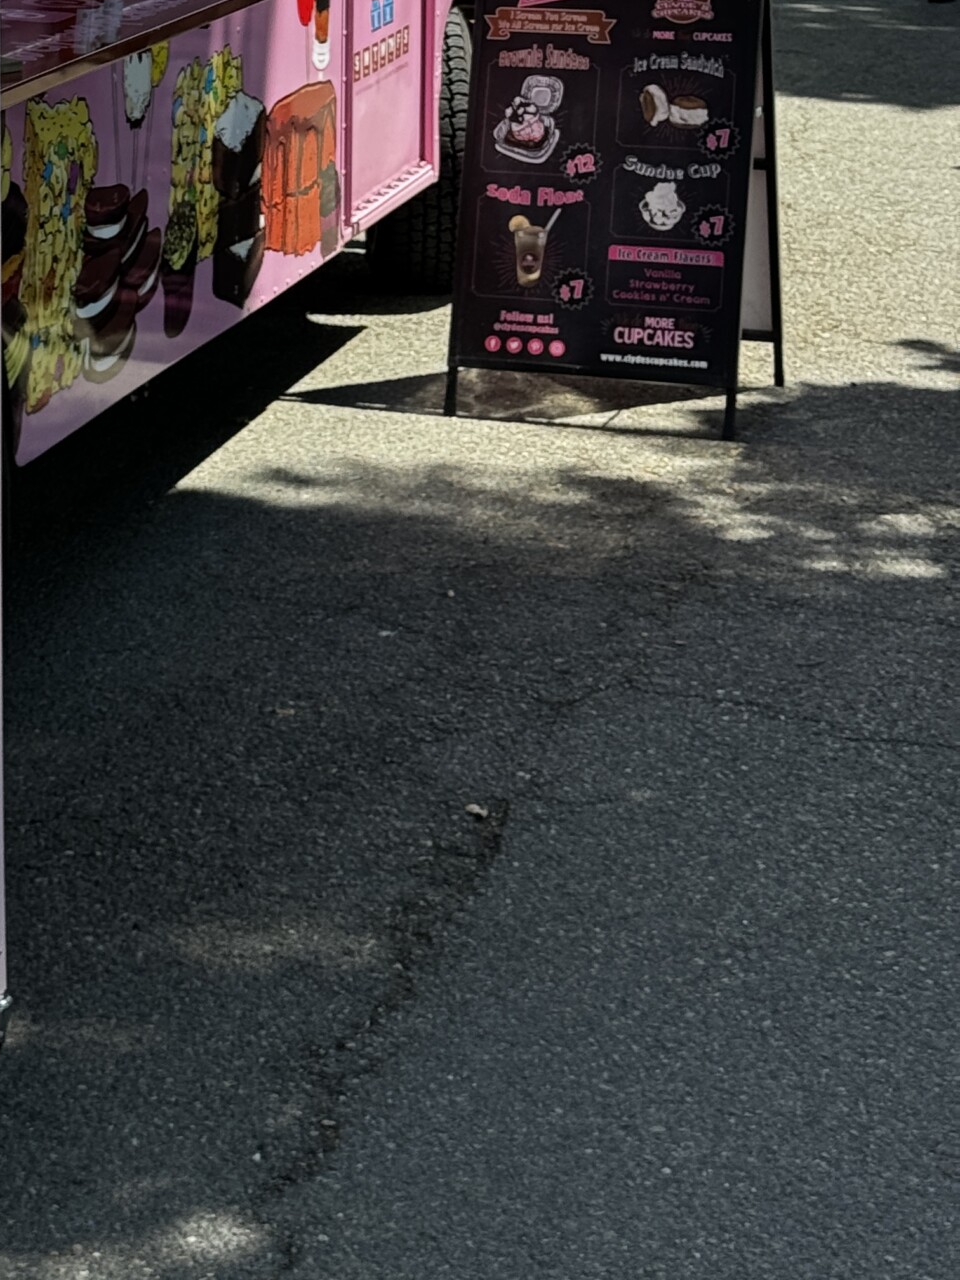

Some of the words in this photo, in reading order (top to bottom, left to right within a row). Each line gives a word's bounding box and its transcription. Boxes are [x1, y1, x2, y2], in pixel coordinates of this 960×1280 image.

[692, 32, 733, 42] CUPCAKES
[622, 154, 684, 180] Sundae
[687, 163, 721, 179] Cup
[618, 249, 632, 259] Ice
[637, 249, 669, 261] Cream
[674, 251, 712, 263] Flavors
[644, 268, 681, 279] Vanilla
[629, 280, 695, 293] Strawberry
[612, 289, 656, 301] Cookies
[673, 294, 711, 305] Cream
[644, 316, 675, 329] MORE
[613, 326, 695, 349] CUPCAKES
[600, 353, 708, 369] www.clydescupcakes.com
